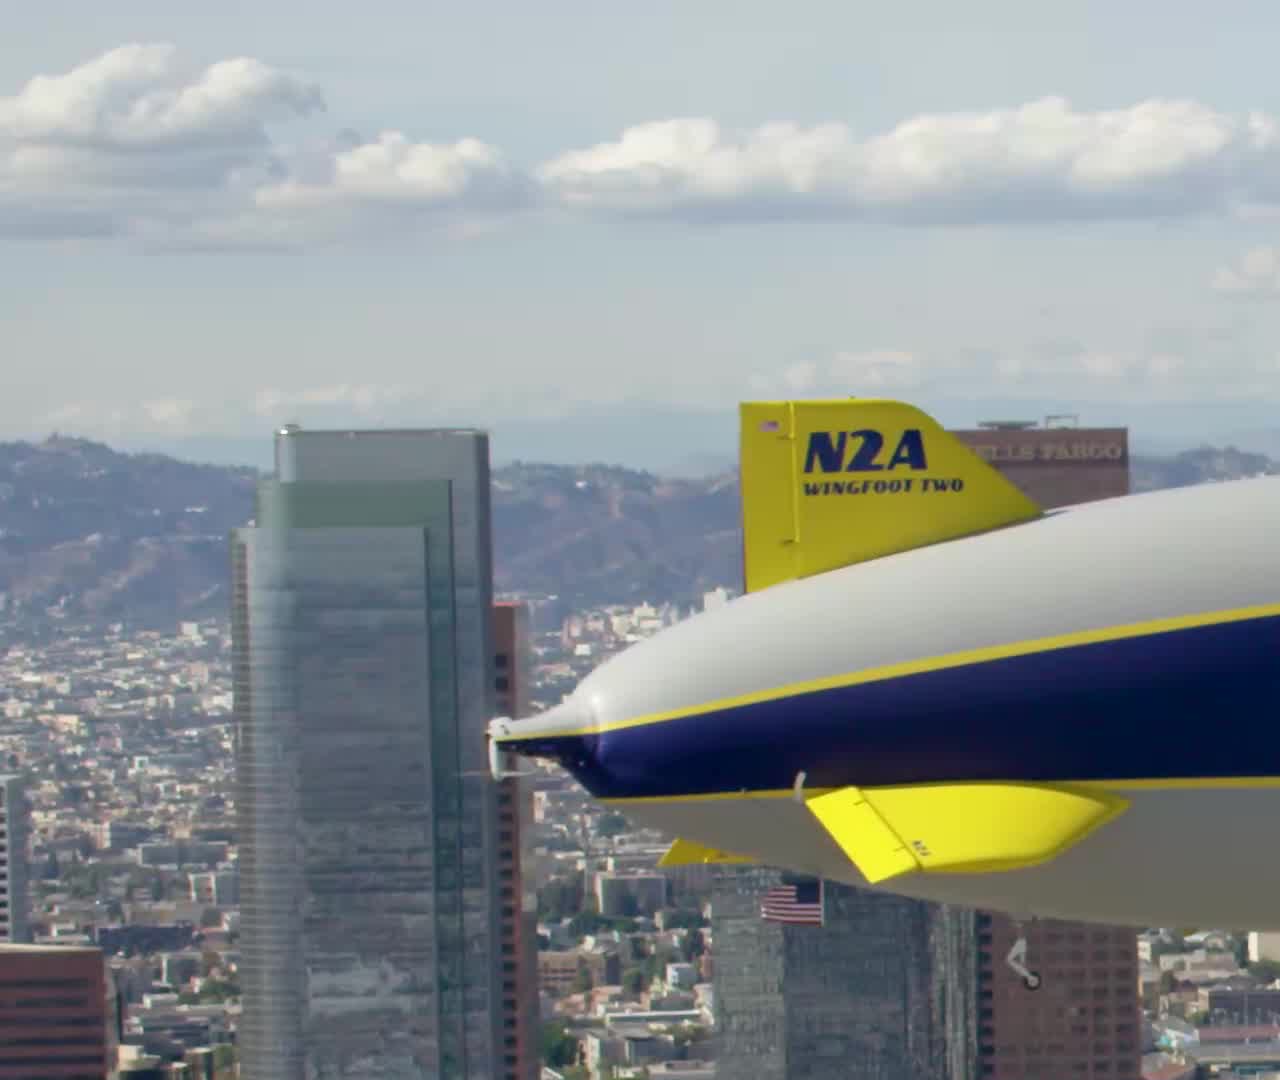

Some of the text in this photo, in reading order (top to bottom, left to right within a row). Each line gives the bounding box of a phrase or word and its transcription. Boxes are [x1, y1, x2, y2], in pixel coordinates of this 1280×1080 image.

[803, 428, 928, 473] N2A
[974, 441, 1122, 461] ELLS FARGO
[803, 478, 965, 496] WINGFOOT TWO
